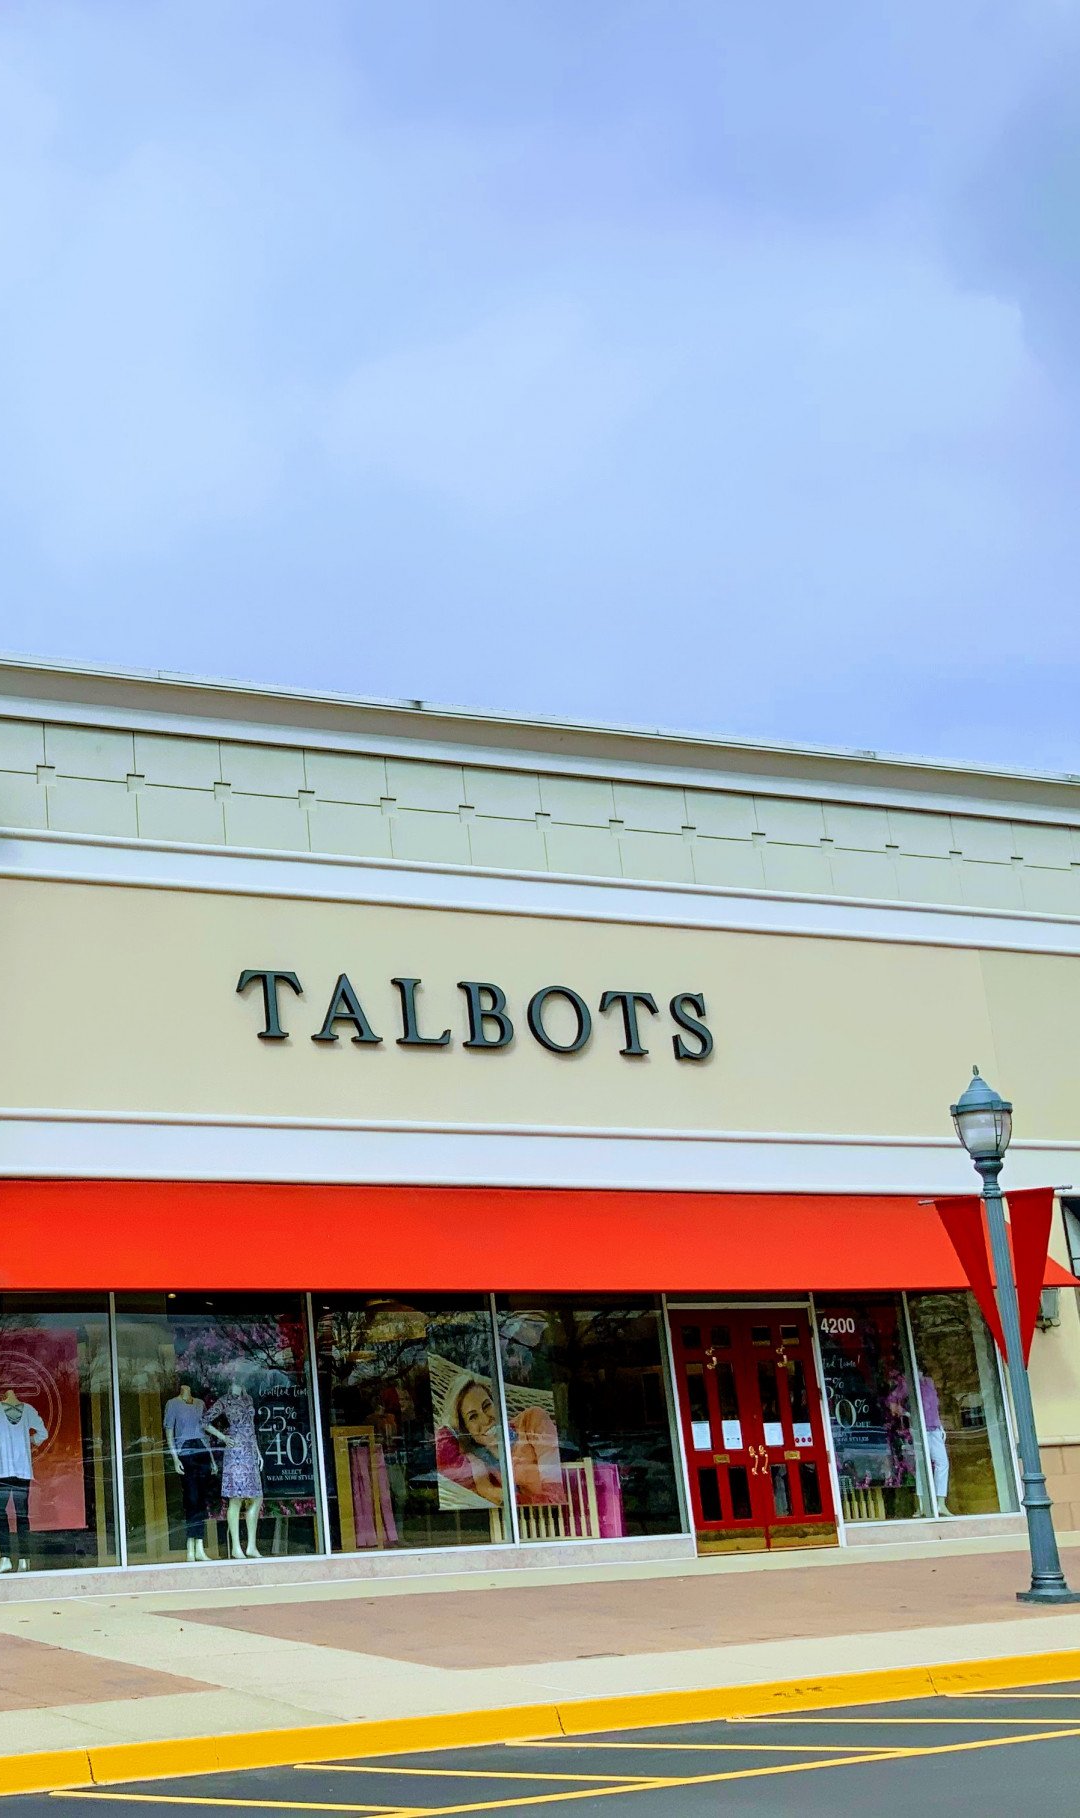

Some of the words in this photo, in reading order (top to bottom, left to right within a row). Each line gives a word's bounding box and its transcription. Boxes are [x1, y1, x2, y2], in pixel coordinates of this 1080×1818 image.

[236, 969, 713, 1061] TALBOTS
[821, 1317, 856, 1334] 4200
[258, 1406, 297, 1431] 25%
